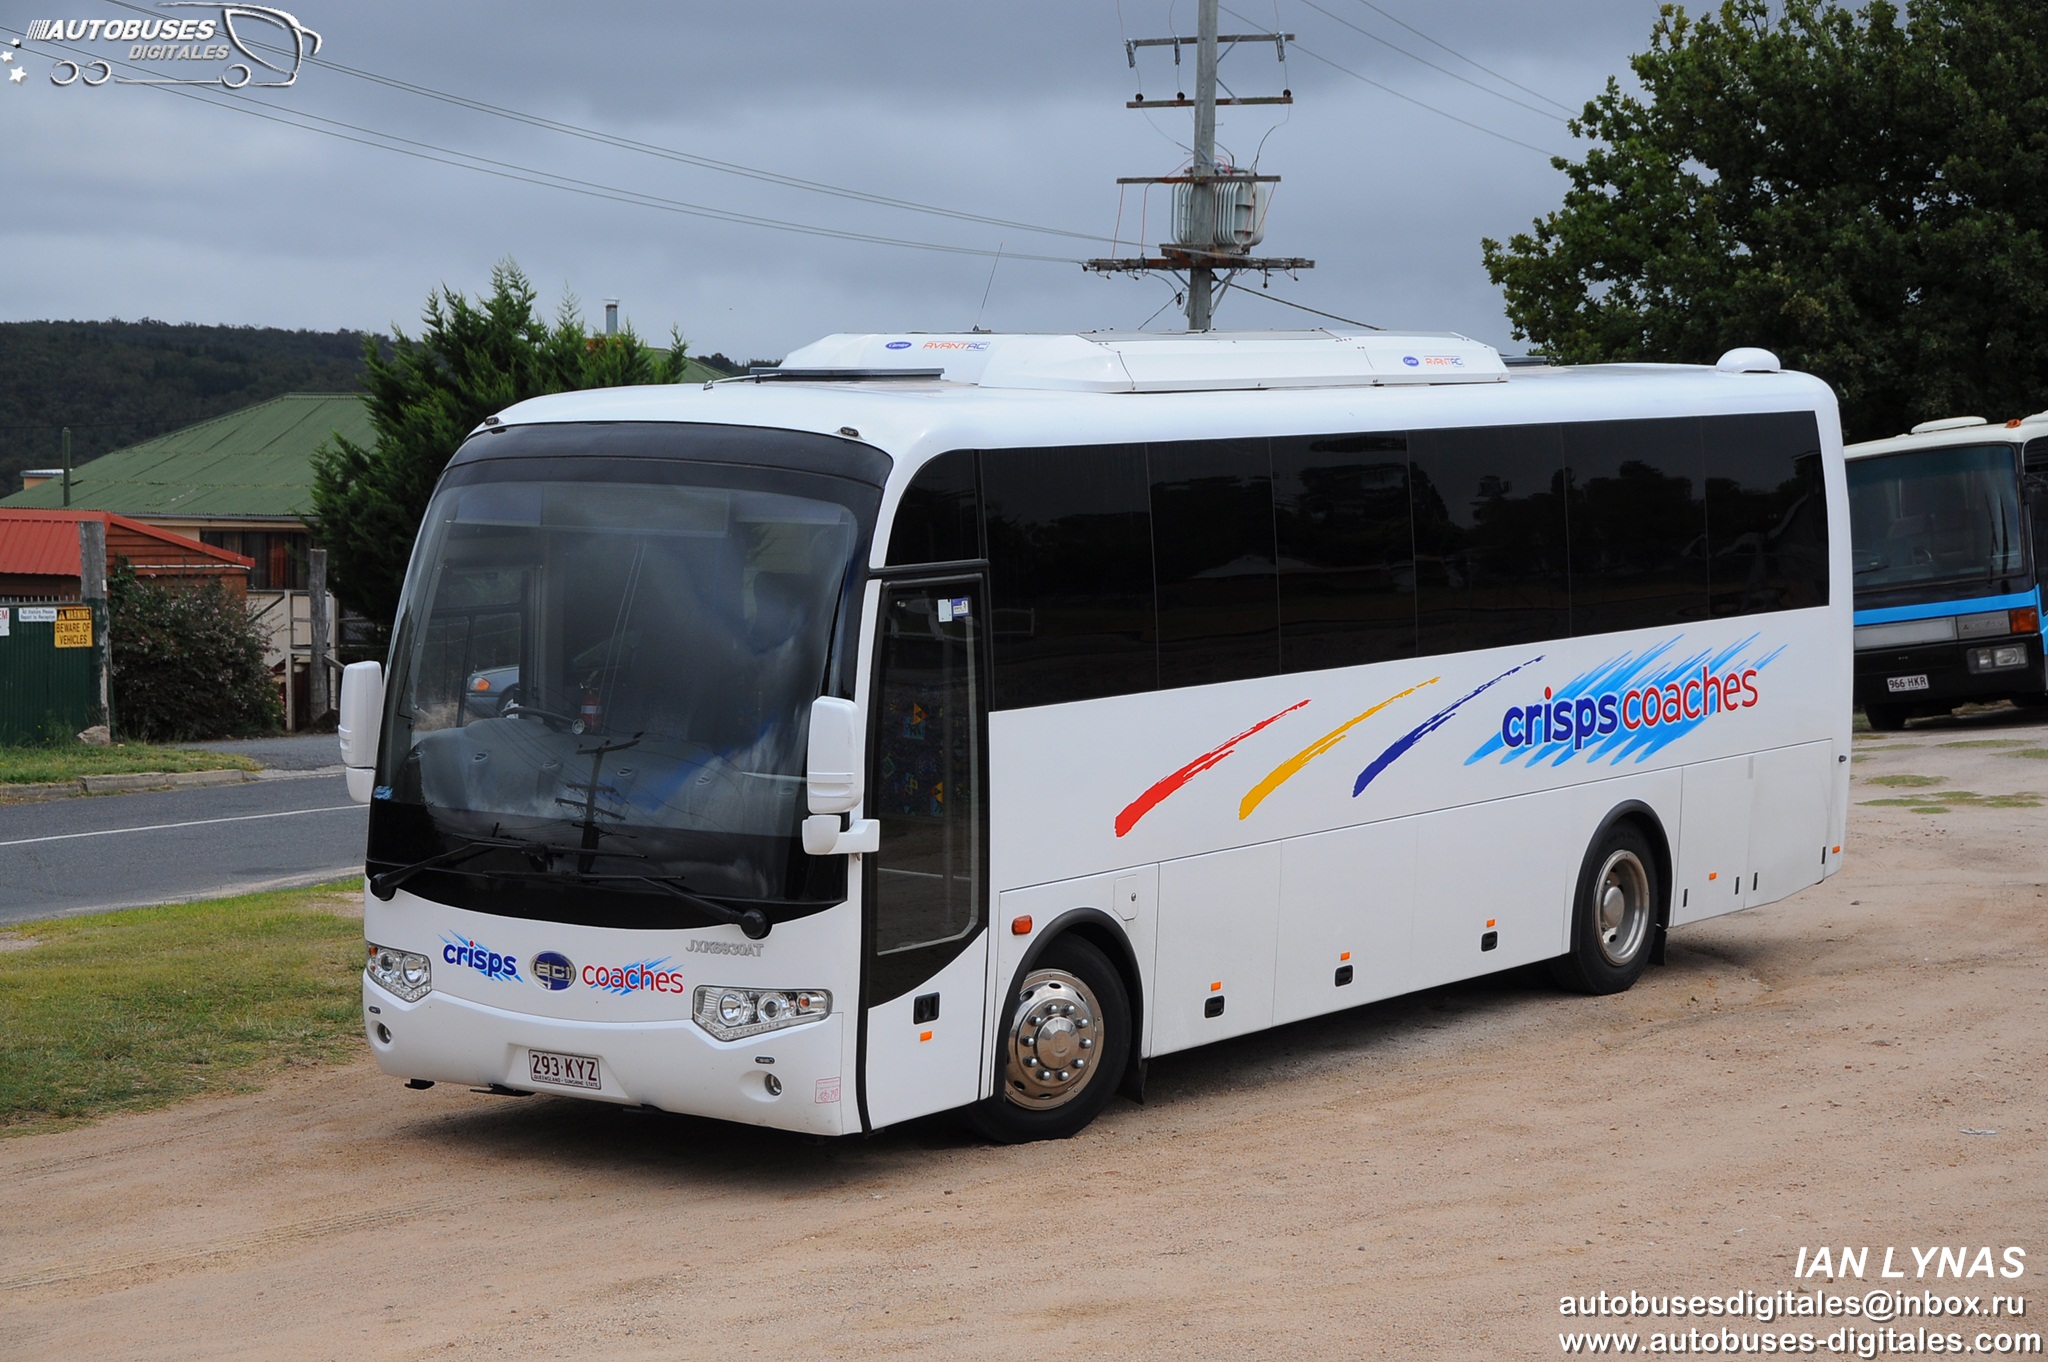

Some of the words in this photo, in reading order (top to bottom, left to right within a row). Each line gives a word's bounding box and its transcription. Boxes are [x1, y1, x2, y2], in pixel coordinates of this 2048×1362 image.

[56, 623, 80, 633] BEWARE
[82, 622, 90, 633] OF
[60, 635, 87, 645] VEHICLES
[443, 940, 517, 977] crisps
[535, 963, 571, 979] BCI
[582, 964, 684, 993] coaches
